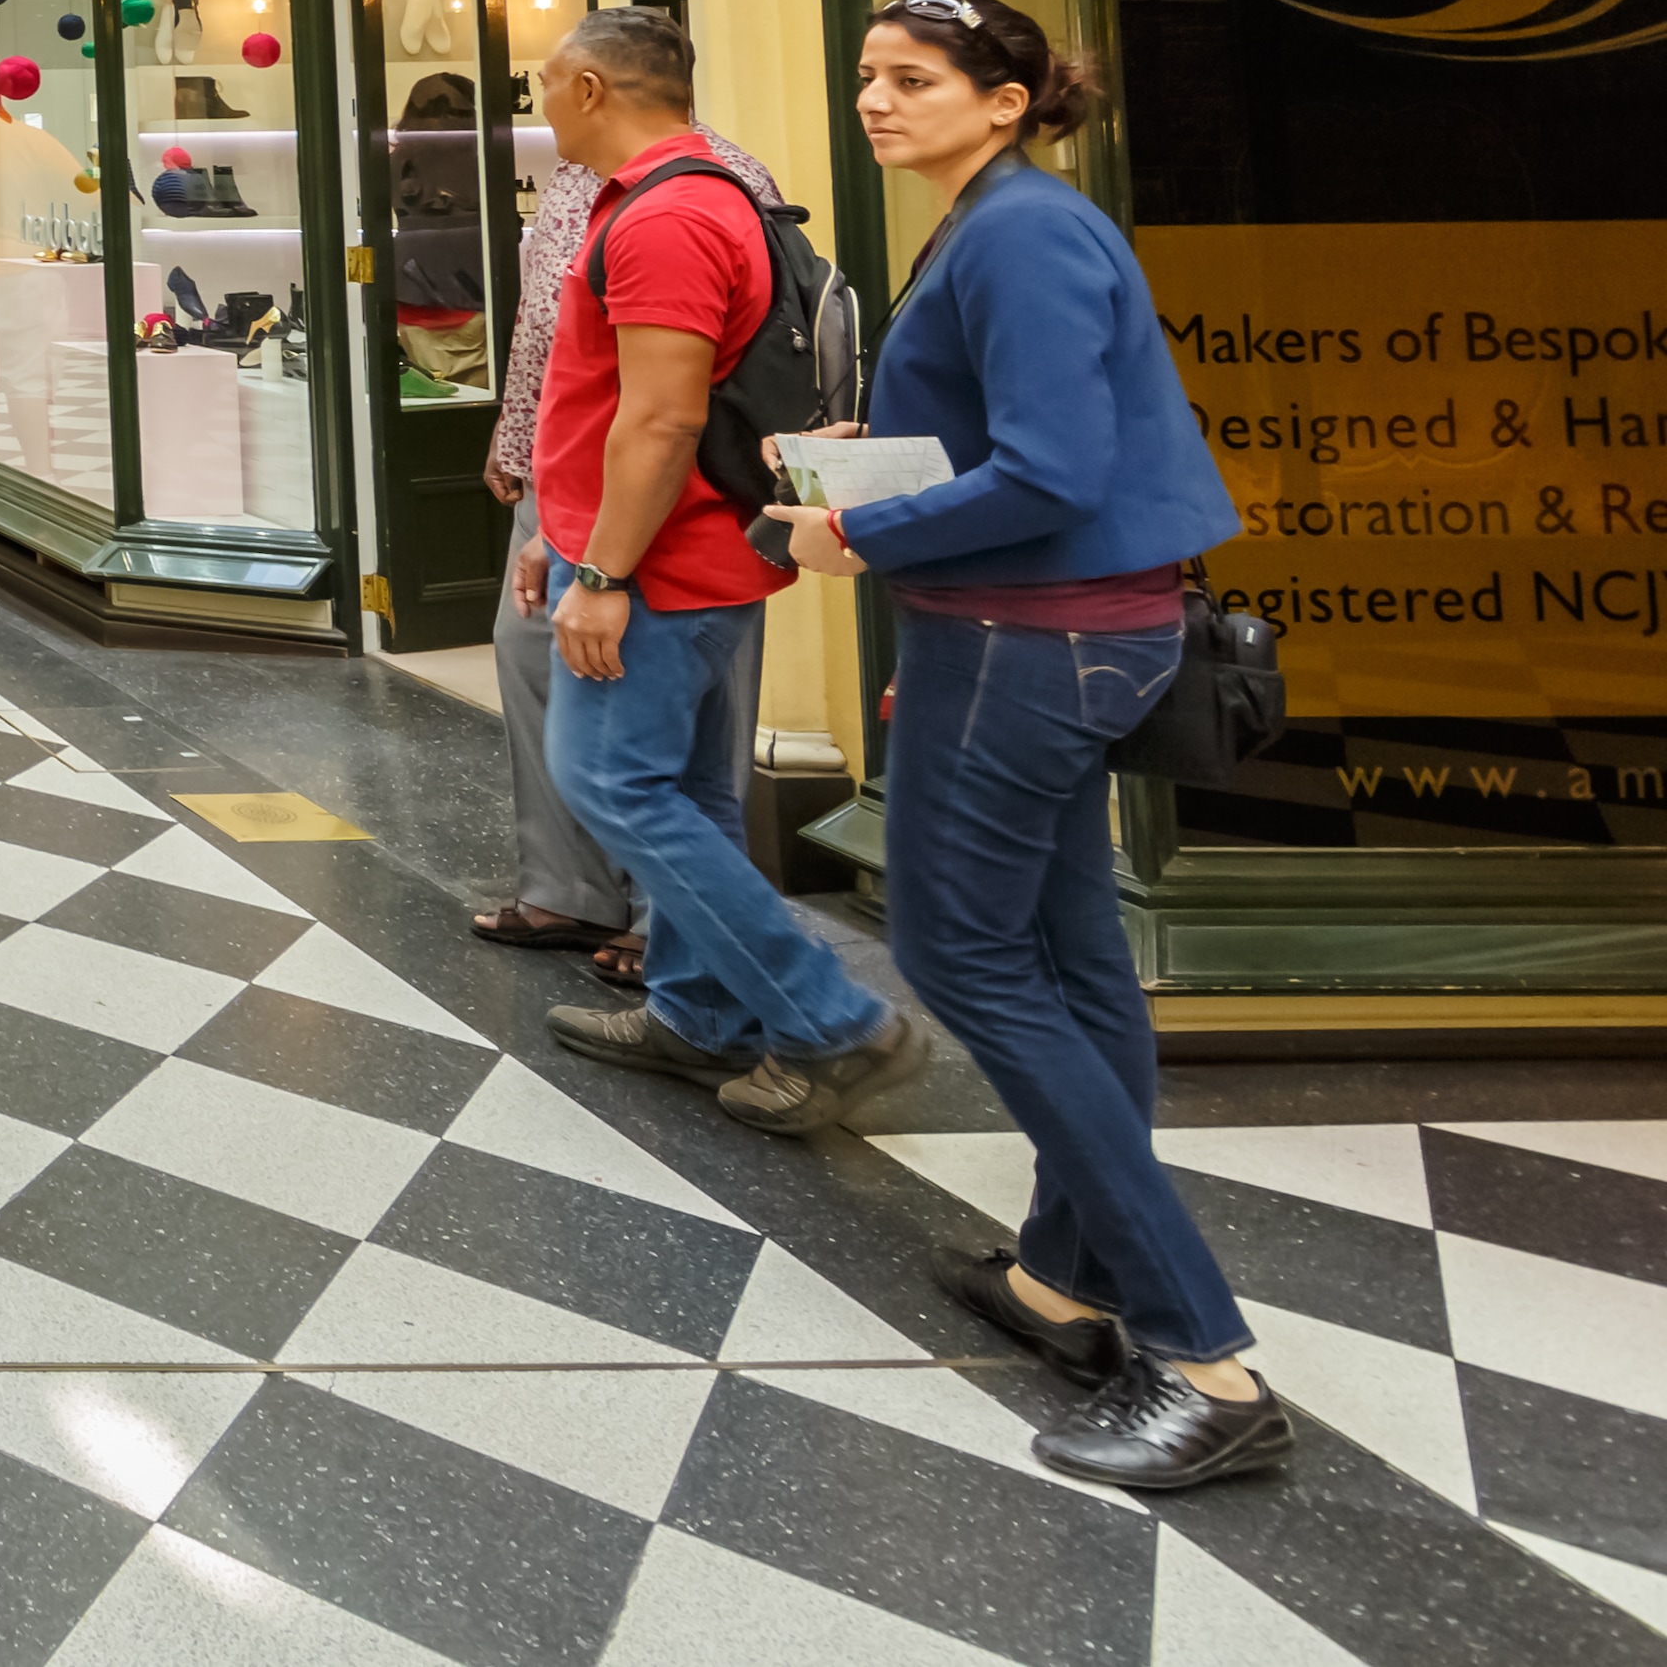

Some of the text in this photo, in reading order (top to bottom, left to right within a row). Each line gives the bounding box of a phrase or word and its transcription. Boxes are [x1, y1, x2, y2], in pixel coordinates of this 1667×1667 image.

[1157, 313, 1361, 363] Makers
[1386, 312, 1443, 362] of
[1490, 399, 1532, 449] &
[1238, 489, 1509, 535] storation
[1535, 485, 1576, 534] &
[1183, 570, 1667, 637] egistered NCJ
